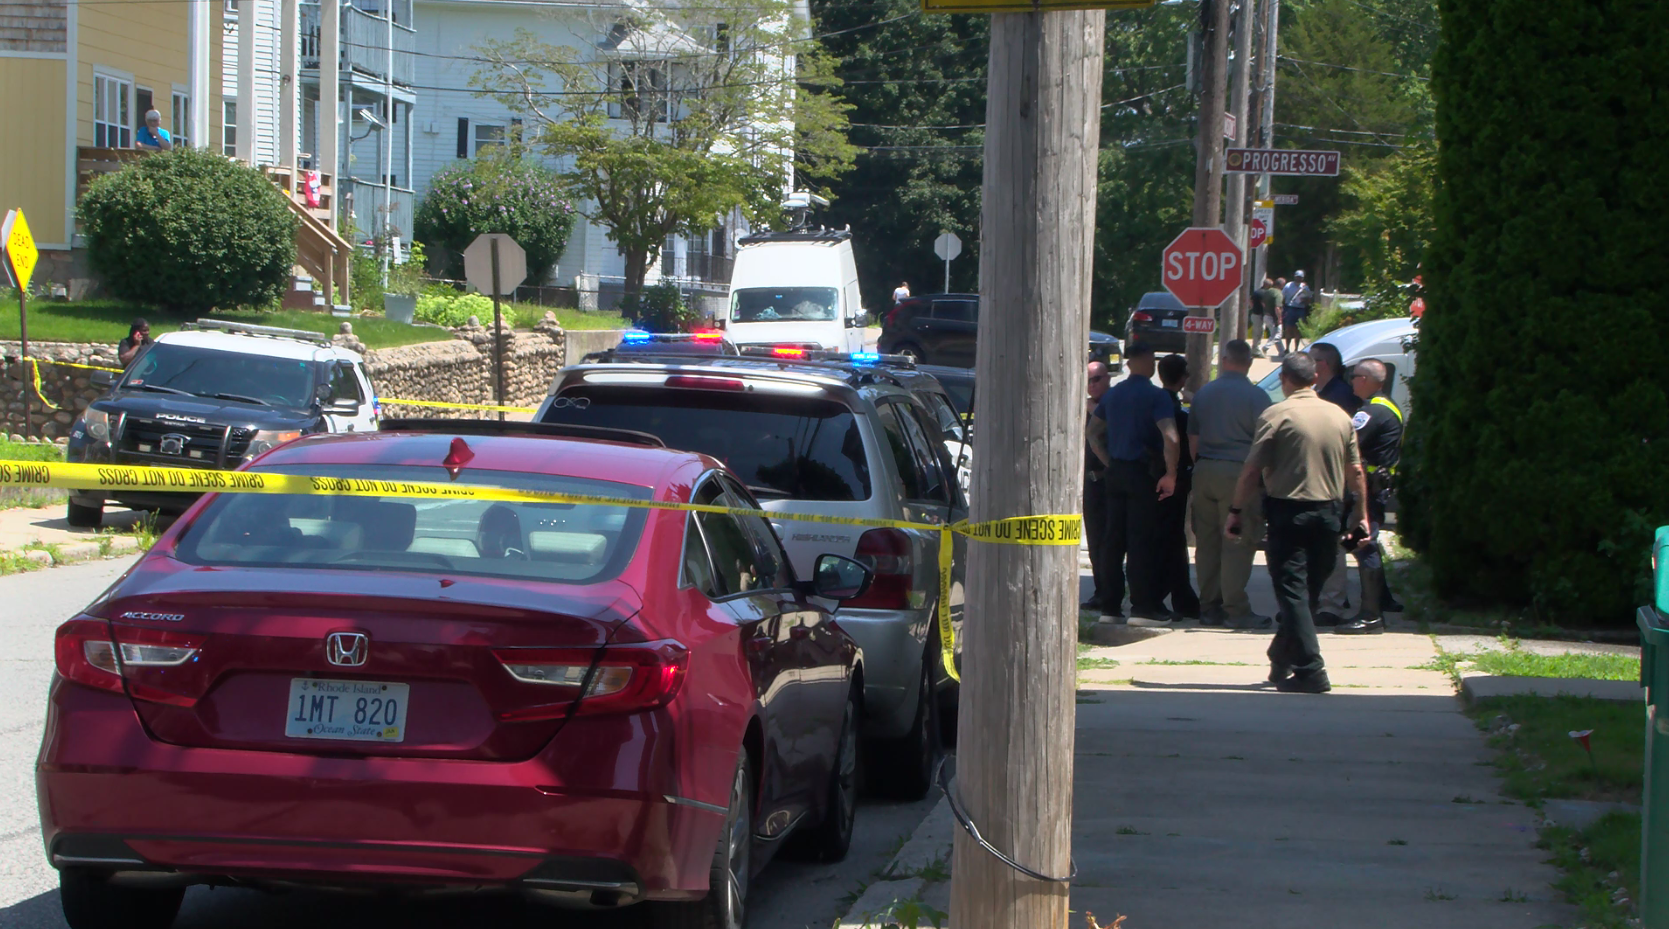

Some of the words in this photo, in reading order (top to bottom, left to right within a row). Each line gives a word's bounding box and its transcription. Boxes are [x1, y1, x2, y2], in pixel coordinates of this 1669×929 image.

[1242, 152, 1326, 173] PROGRESSO
[1251, 228, 1265, 239] OP
[17, 253, 29, 269] END
[1167, 251, 1237, 280] STOP
[1185, 320, 1213, 330] 4-WAY
[155, 413, 206, 424] POLICE
[15, 465, 50, 483] CRIME
[98, 468, 138, 485] CROSS
[142, 469, 166, 486] NOT
[169, 470, 186, 487] DO
[190, 471, 226, 487] SCENE
[230, 473, 264, 488] CRIME
[973, 522, 991, 537] NOT
[995, 521, 1011, 539] DO
[1015, 519, 1055, 541] SCENE
[120, 611, 185, 621] ACCORD
[318, 683, 350, 694] Rhode
[353, 684, 382, 695] Island
[295, 694, 339, 723] 1MT
[354, 697, 398, 725] 820
[313, 723, 345, 735] Ocean
[347, 725, 377, 737] State
